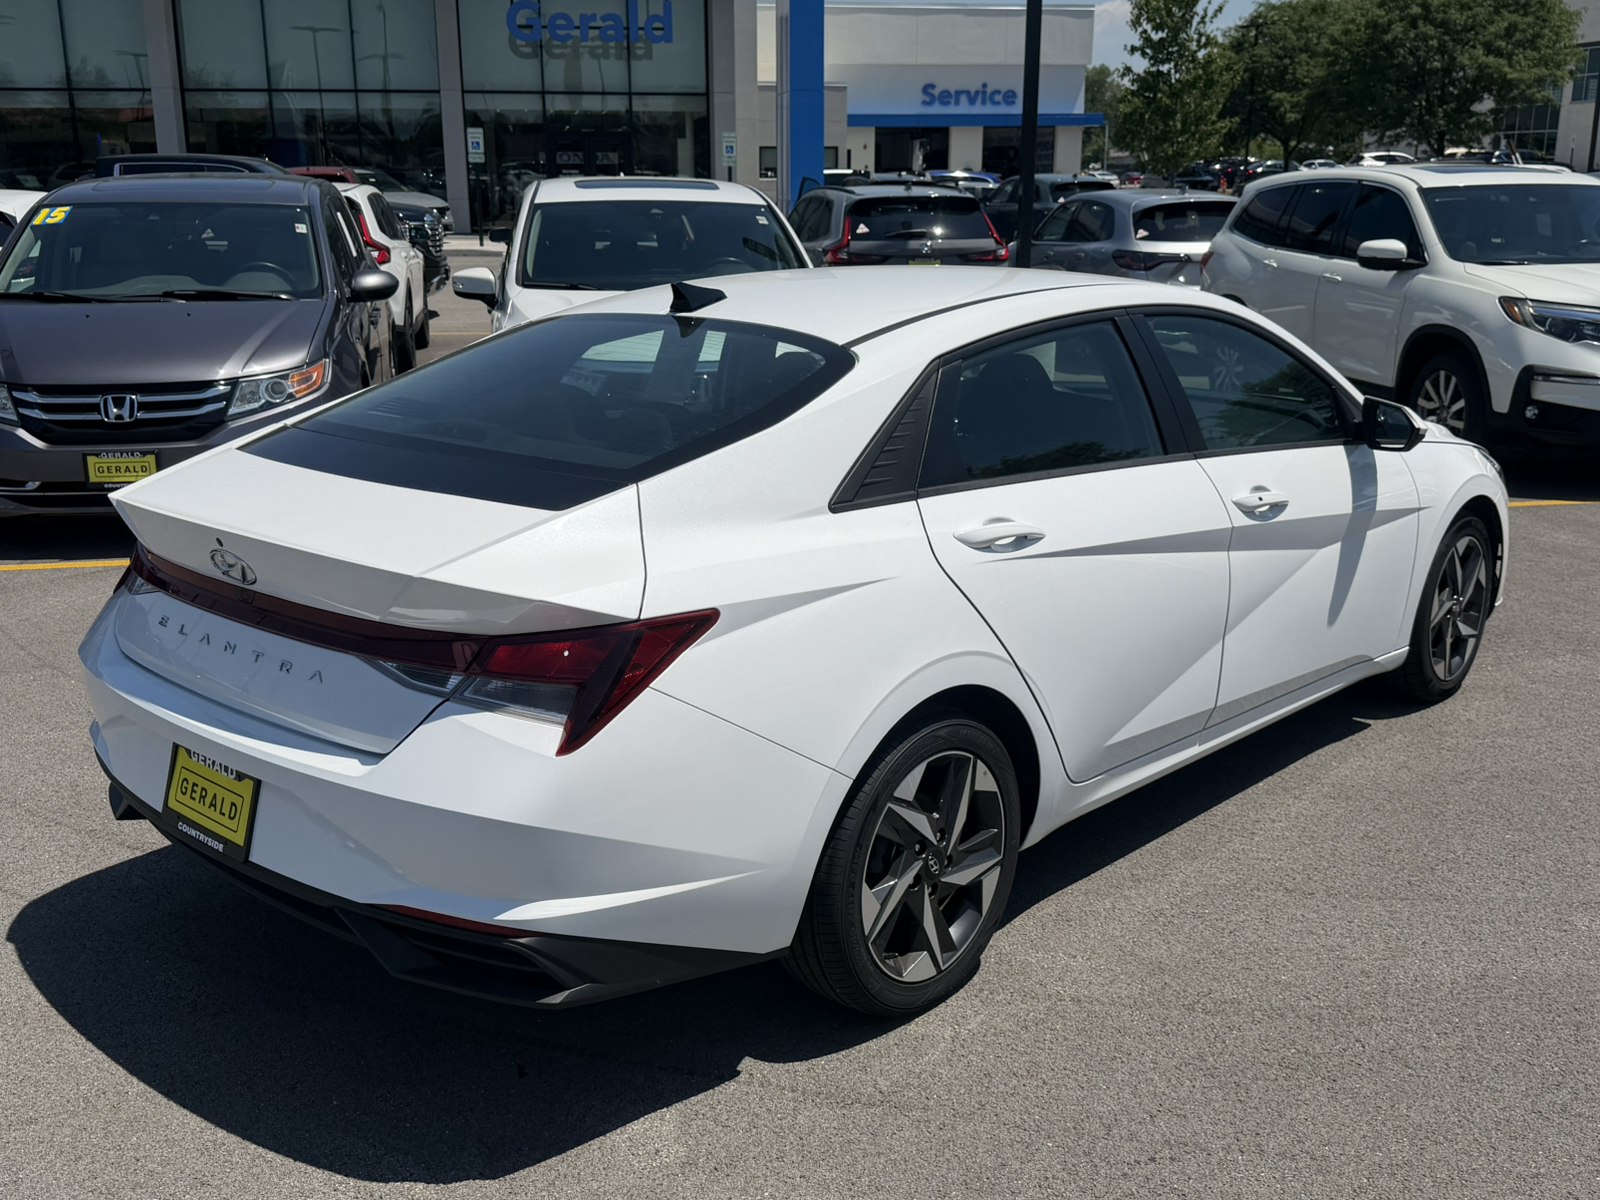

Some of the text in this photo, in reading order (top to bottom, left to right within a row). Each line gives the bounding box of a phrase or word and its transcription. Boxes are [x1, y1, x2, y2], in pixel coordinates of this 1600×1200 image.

[506, 0, 673, 44] Gerald
[921, 82, 1018, 106] Service
[32, 206, 72, 226] 15
[97, 465, 148, 474] GERALD
[158, 614, 323, 683] ELANTRA
[191, 749, 236, 779] GERALD
[180, 777, 238, 821] GERALD
[177, 821, 224, 853] COUNTRYSIDE
